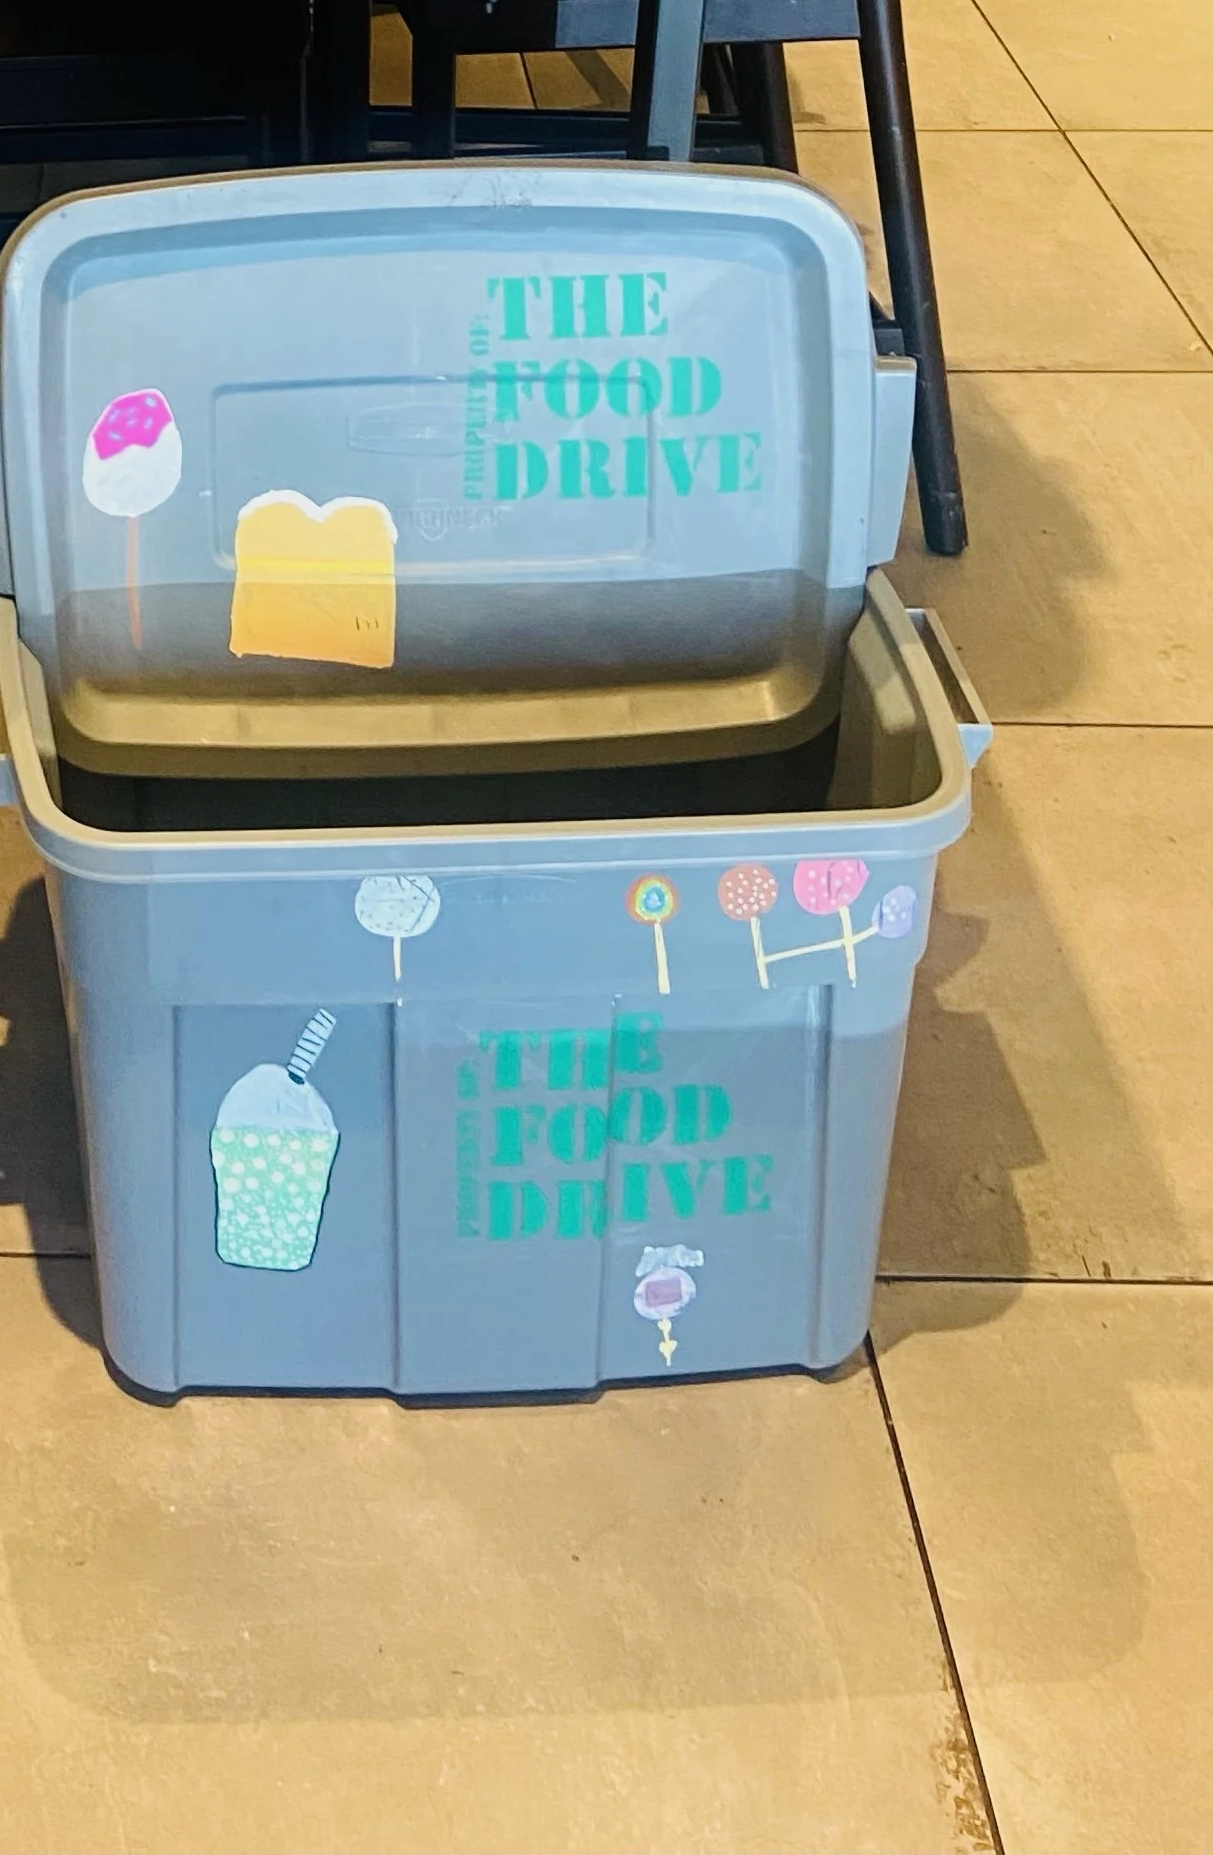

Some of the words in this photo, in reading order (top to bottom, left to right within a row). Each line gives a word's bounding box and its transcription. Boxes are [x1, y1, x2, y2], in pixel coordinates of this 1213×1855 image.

[486, 272, 669, 340] THE
[492, 356, 723, 423] FOOD
[493, 431, 763, 502] DRIVE
[478, 1011, 664, 1091] THE
[490, 1083, 733, 1166] FOOD
[486, 1153, 775, 1241] DRIVE
